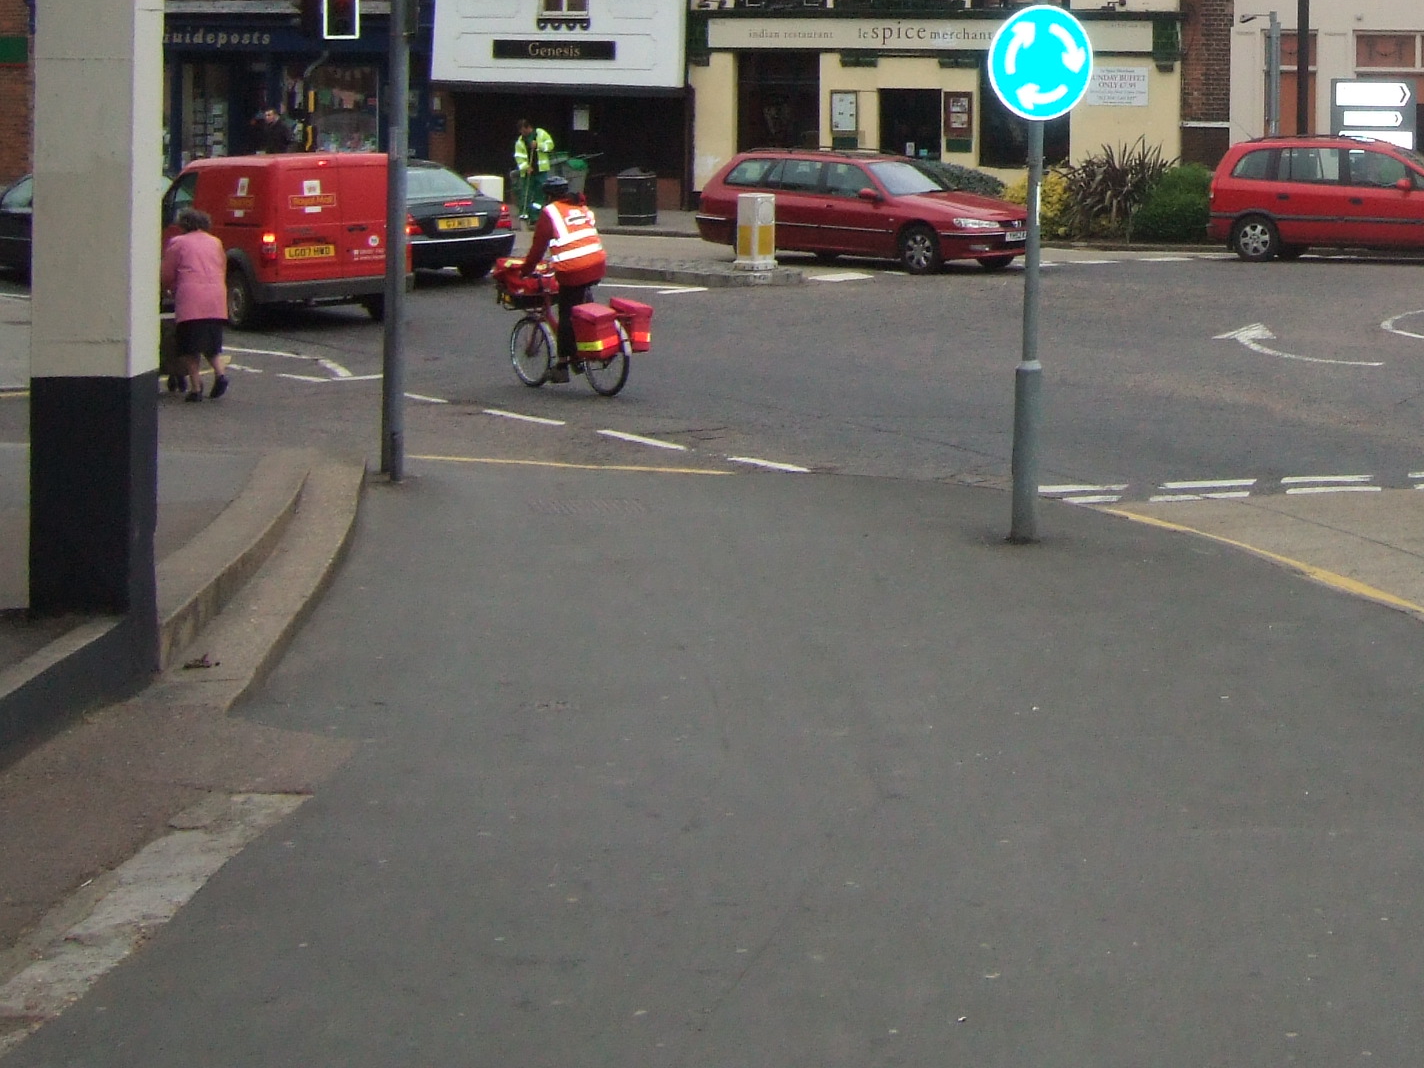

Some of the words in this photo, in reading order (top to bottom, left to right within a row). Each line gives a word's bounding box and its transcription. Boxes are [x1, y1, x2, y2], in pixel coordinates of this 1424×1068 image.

[749, 29, 780, 39] indian
[784, 30, 834, 39] restaurant
[871, 21, 926, 45] spice
[930, 28, 992, 40] merchant
[528, 42, 581, 57] Genesis
